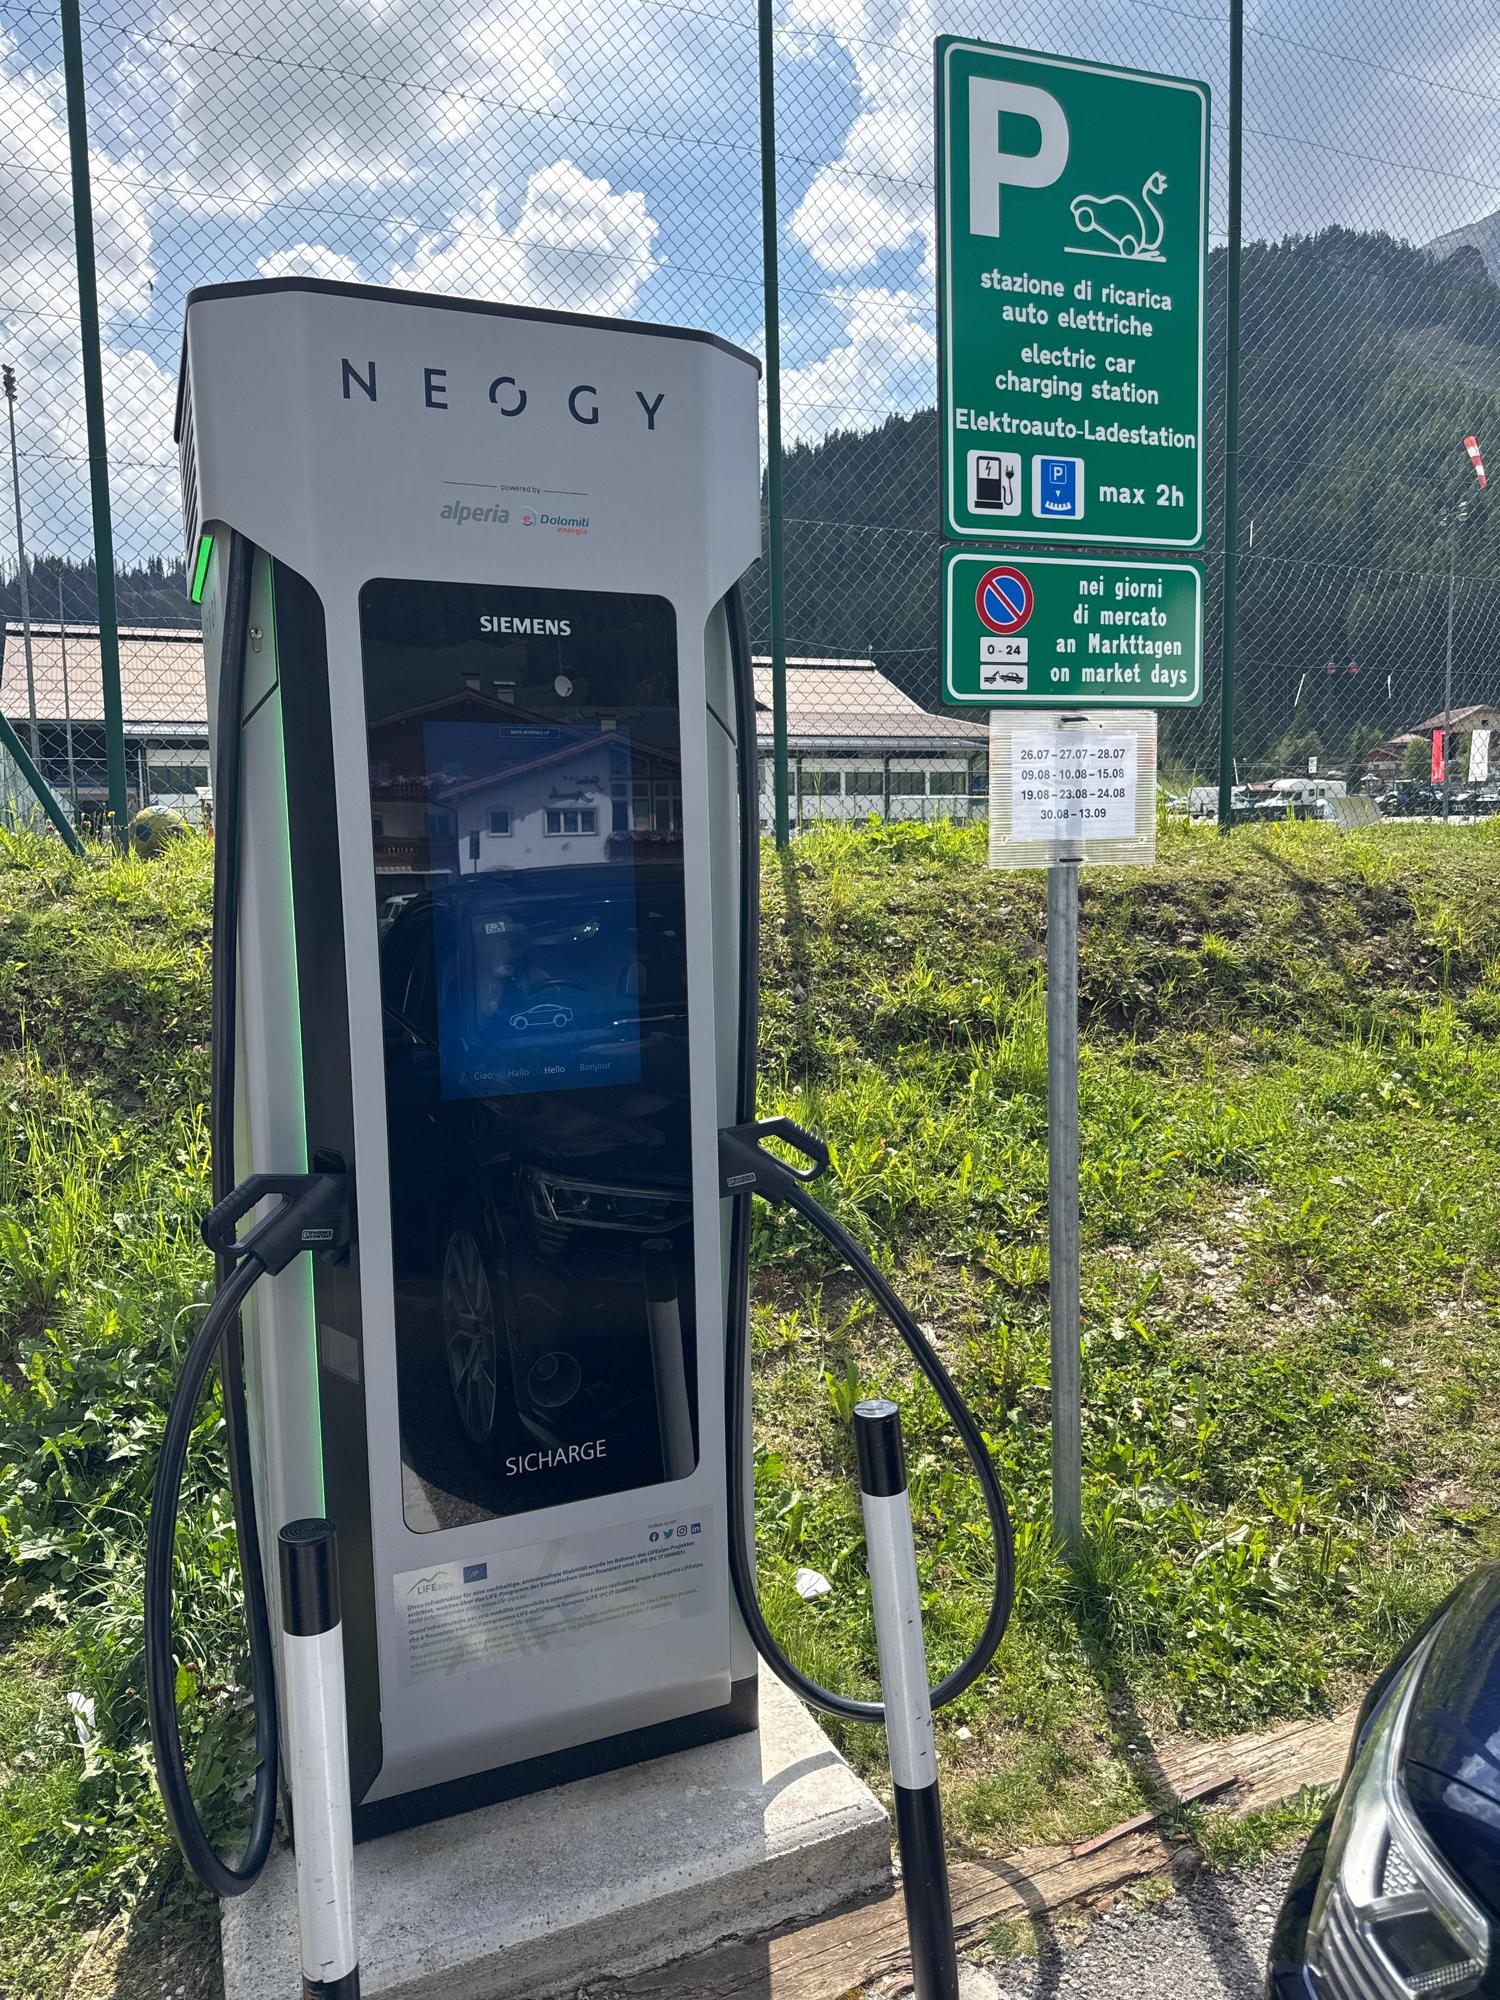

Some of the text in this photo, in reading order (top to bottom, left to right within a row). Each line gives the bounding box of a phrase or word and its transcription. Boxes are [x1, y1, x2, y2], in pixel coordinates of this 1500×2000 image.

[968, 75, 1069, 238] P
[981, 269, 1172, 310] stazione di ricarica
[1003, 303, 1152, 337] auto elettriche
[1021, 343, 1135, 373] electric car
[341, 358, 665, 430] NEOGY
[996, 370, 1158, 404] charging station
[956, 408, 1195, 448] Elektroauto-Ladestation
[501, 484, 540, 495] powered by
[1052, 466, 1183, 507] P max 2h
[441, 501, 510, 525] alperia
[540, 514, 589, 527] Dolomiti
[557, 527, 587, 536] energia
[1080, 576, 1162, 600] nei giorni
[480, 616, 571, 636] SIEMENS
[1074, 604, 1167, 626] di mercato
[988, 645, 994, 654] 0
[1006, 645, 1021, 655] 24
[1056, 633, 1181, 658] an Markttagen
[1051, 663, 1187, 687] on market days
[1021, 750, 1049, 759] 26.07
[1059, 750, 1087, 759] 27.07
[1098, 749, 1125, 759] 28.07
[1022, 770, 1050, 780] 09.08
[1060, 769, 1086, 779] 10.08
[1097, 769, 1124, 778] 15.08
[1022, 790, 1049, 800] 19.08
[1060, 789, 1087, 799] 23.08
[1098, 788, 1125, 798] 24.08
[1041, 810, 1068, 819] 30.08
[1080, 808, 1106, 818] 13.09
[474, 1062, 611, 1080] Ciao Hallo Hello Bonjour
[505, 1439, 606, 1476] SICHARGE
